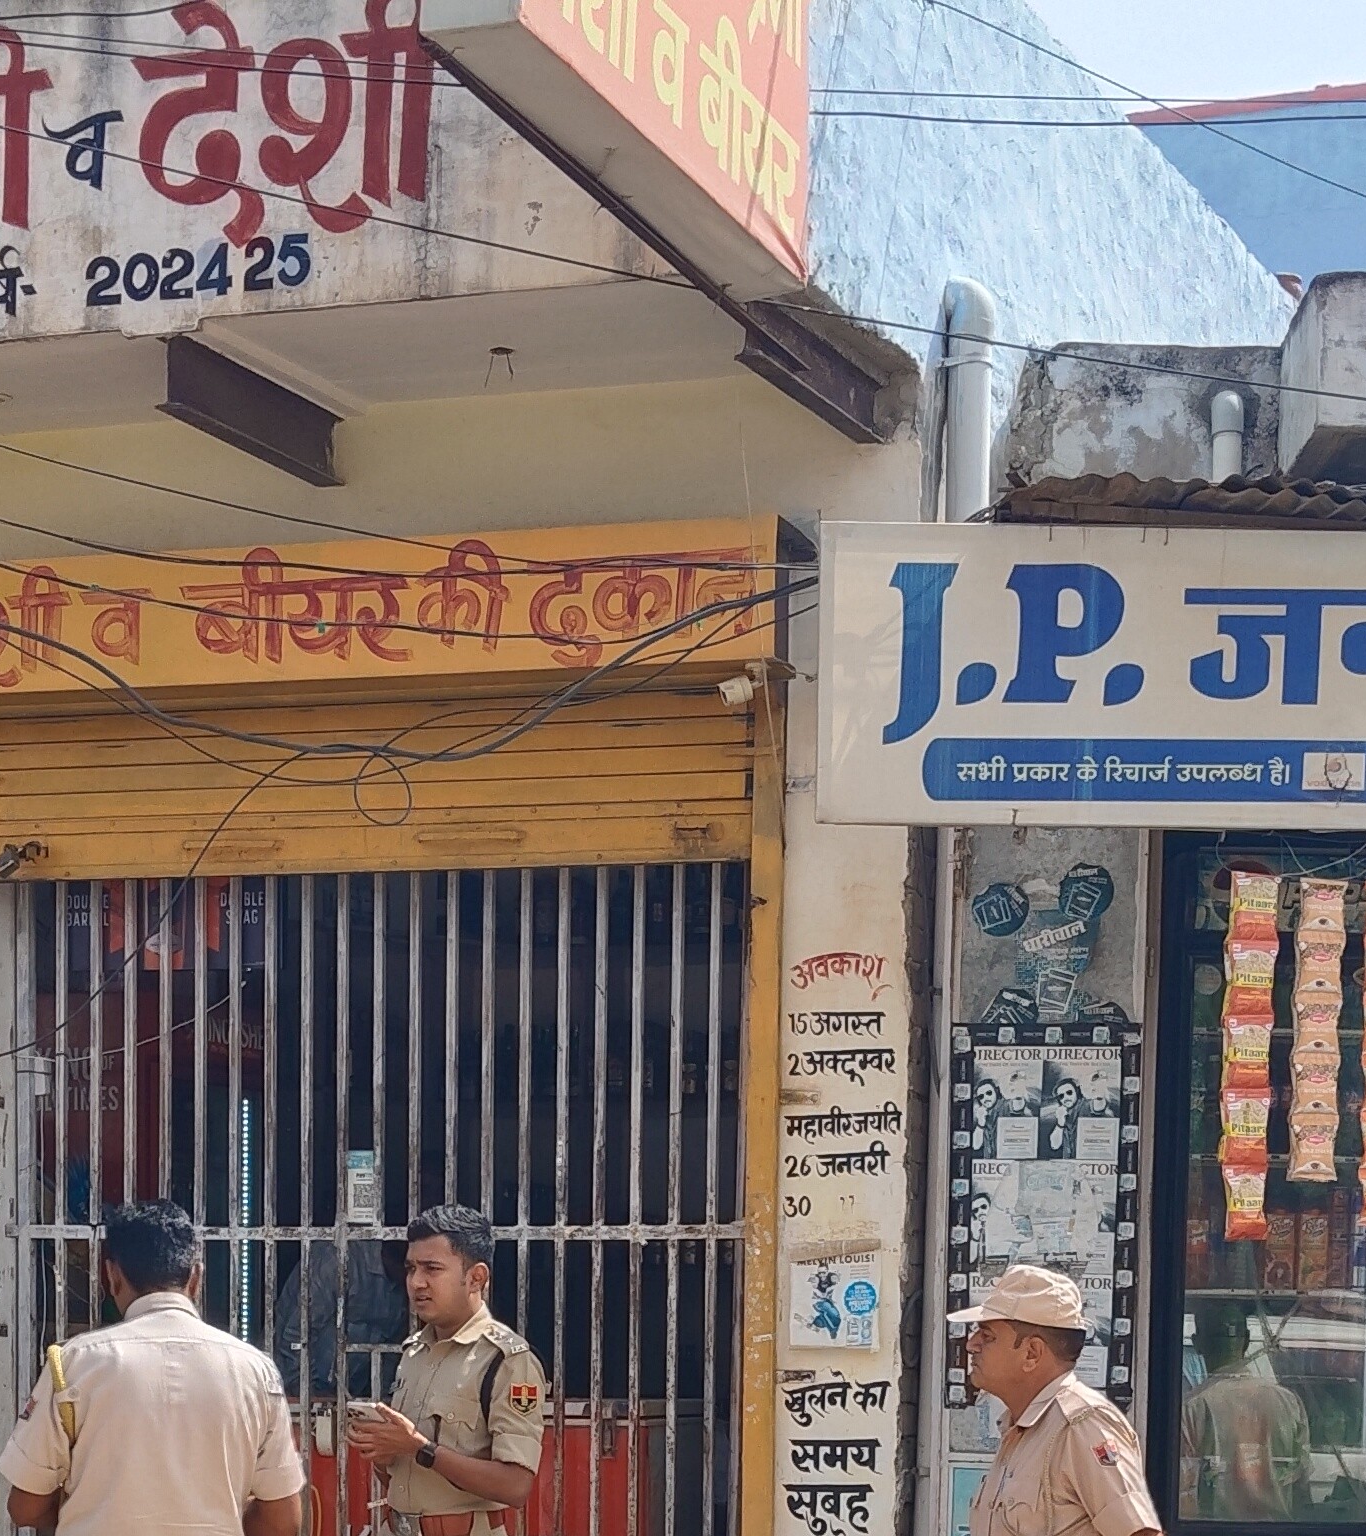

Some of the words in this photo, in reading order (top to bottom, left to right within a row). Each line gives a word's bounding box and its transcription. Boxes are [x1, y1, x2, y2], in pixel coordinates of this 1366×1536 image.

[42, 109, 123, 191] व
[957, 755, 1008, 783] सभी
[1011, 762, 1071, 783] प्रकार
[1075, 756, 1099, 783] के
[1104, 755, 1173, 783] रिचार्ज
[1176, 763, 1264, 783] उपलब्ध
[808, 1011, 886, 1037] अगस्त
[816, 1140, 891, 1178] जनवरी
[853, 1381, 892, 1415] का
[789, 1438, 883, 1475] समय
[782, 1483, 875, 1536] सुबह
